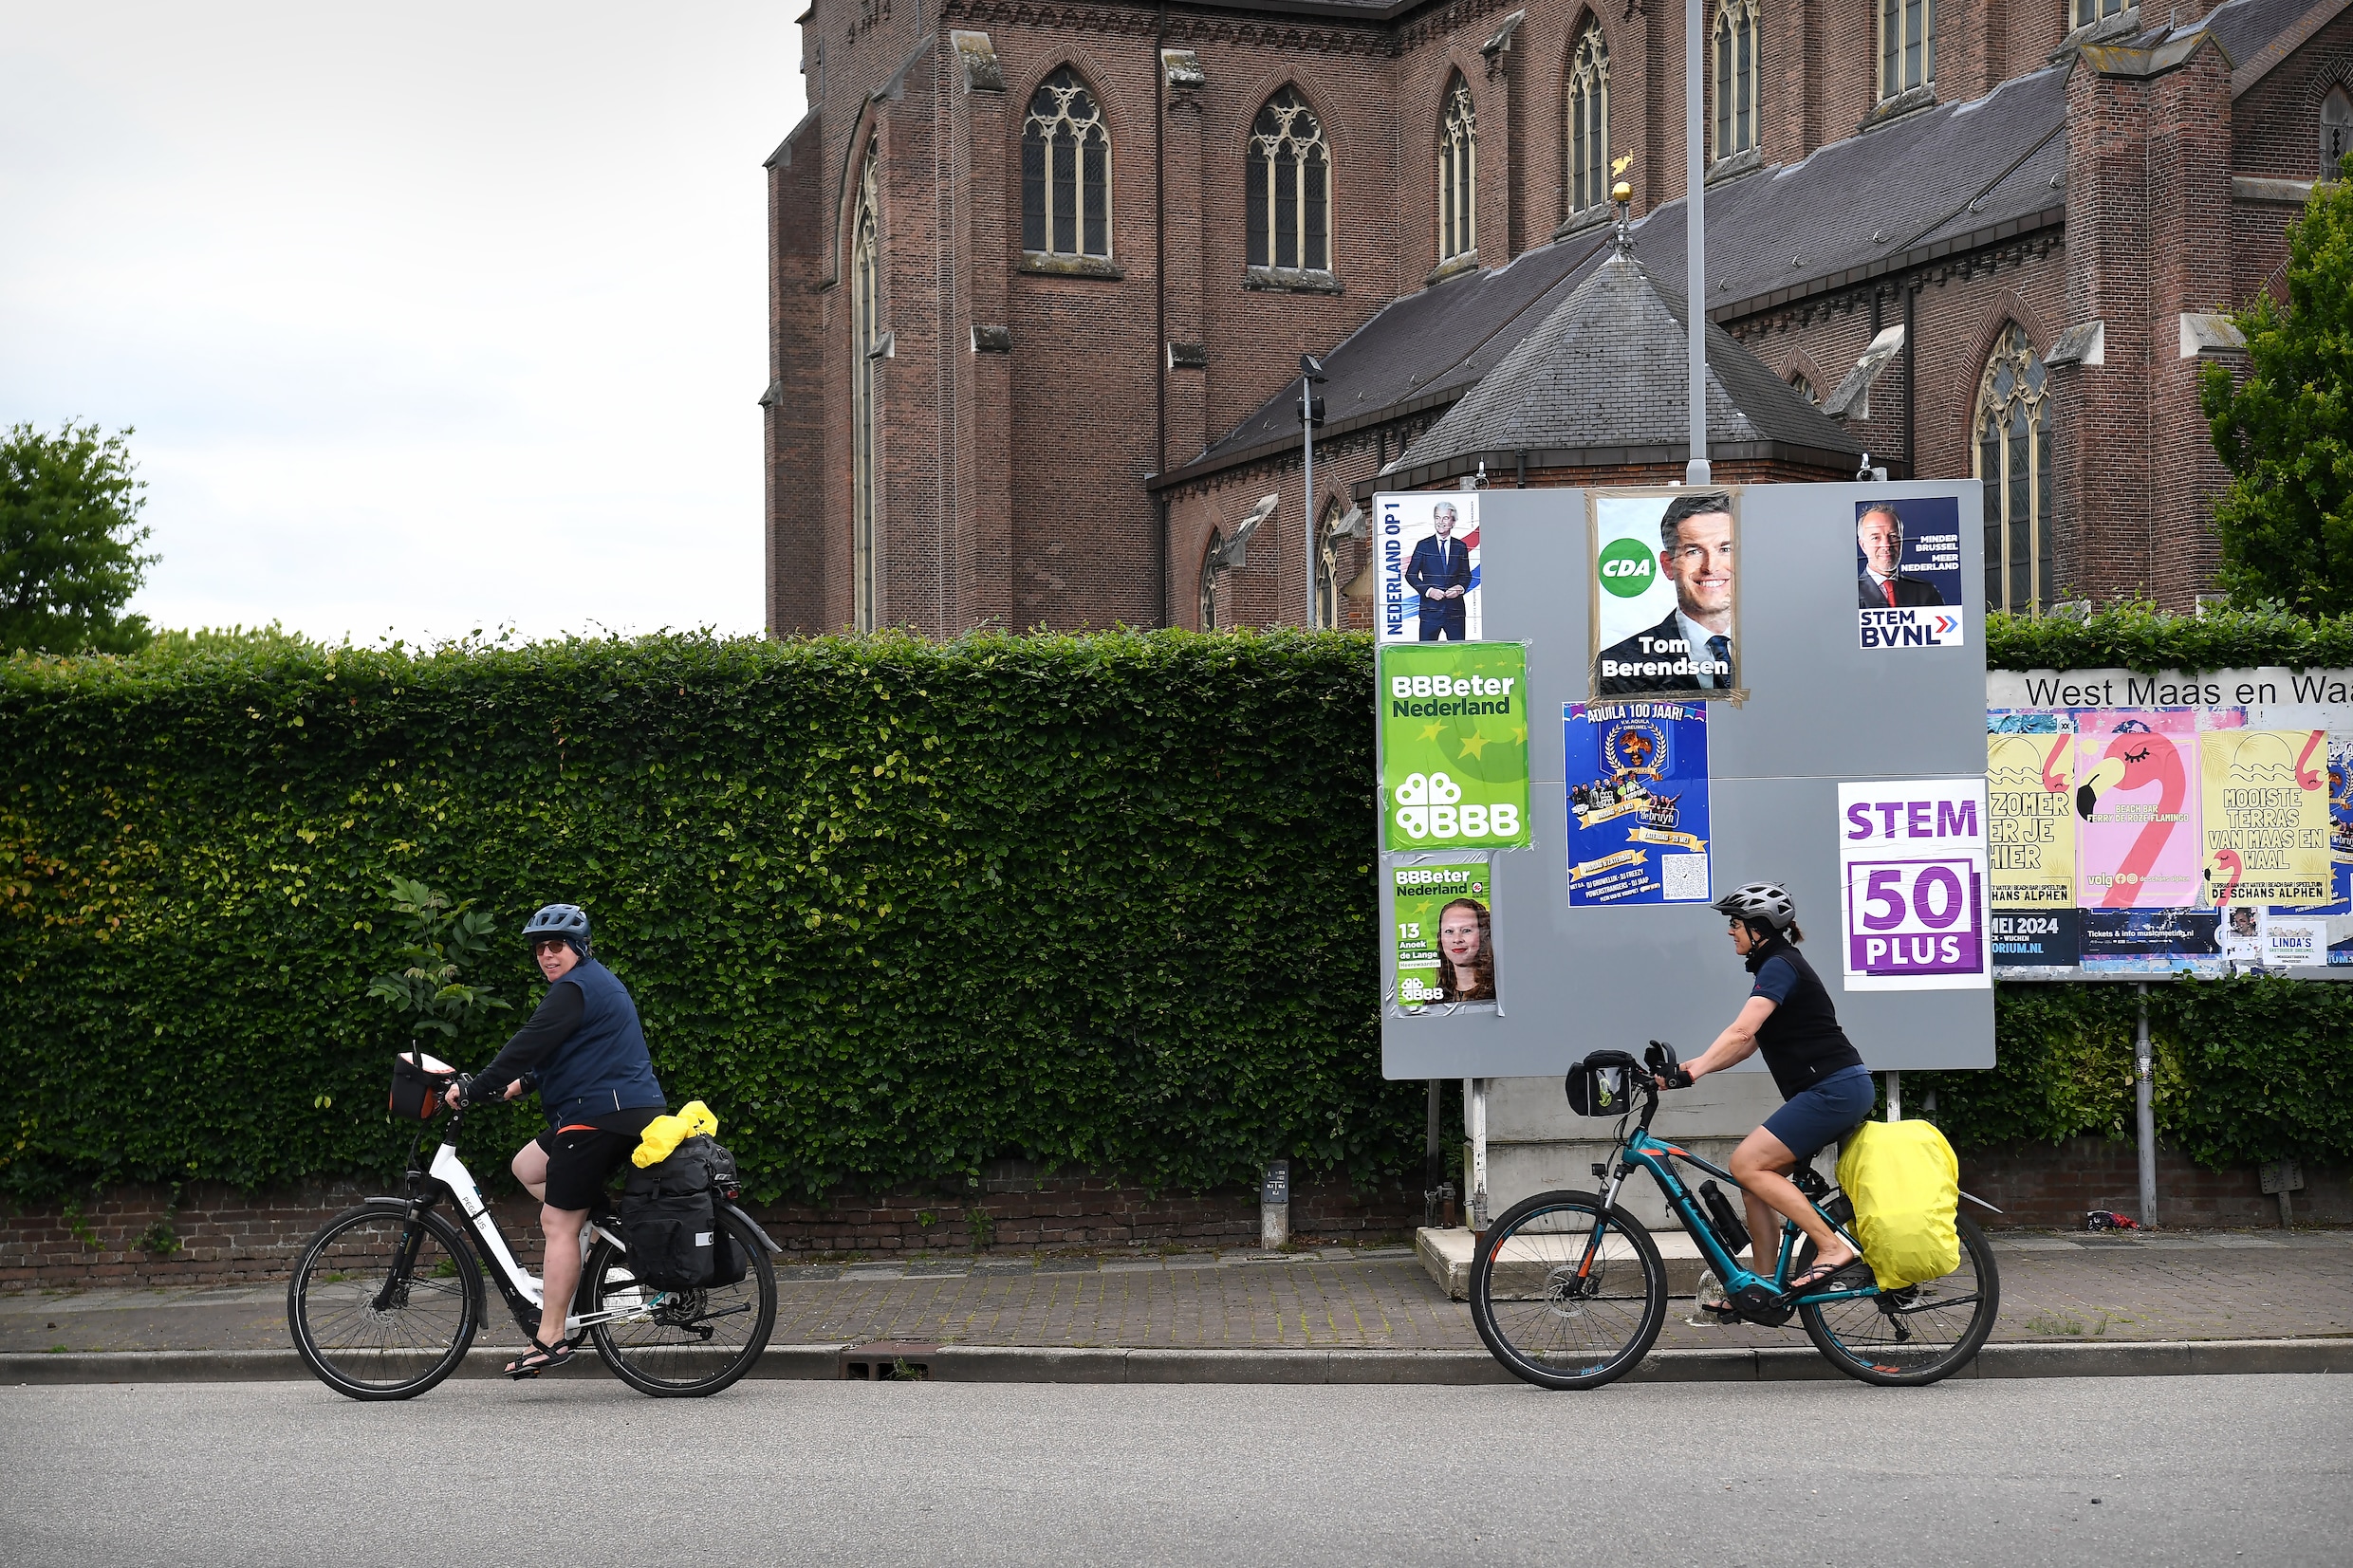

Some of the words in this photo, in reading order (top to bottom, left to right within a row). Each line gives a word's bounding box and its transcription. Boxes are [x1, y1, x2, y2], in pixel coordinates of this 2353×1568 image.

[1385, 513, 1400, 535] OP
[1916, 543, 1958, 552] BRUSSEL
[1920, 534, 1958, 544] MINDER
[1602, 559, 1650, 577] CDA
[1901, 563, 1959, 572] NEDERLAND
[1932, 554, 1958, 563] MEER
[1386, 540, 1402, 636] NEDERLAND
[1861, 610, 1916, 625] STEM
[1639, 636, 1691, 655] Tom
[1861, 625, 1941, 648] BVNL
[1602, 657, 1729, 677] Berendsen
[1392, 674, 1515, 698] BBBeter
[2026, 678, 2113, 706] West
[2128, 678, 2221, 705] Maas
[2235, 683, 2276, 704] en
[1393, 697, 1510, 717] Nederland
[1587, 705, 1626, 724] AQUILA
[1629, 704, 1650, 718] 100
[1652, 704, 1684, 721] JAAR!
[1991, 791, 2069, 817] ZOMER
[2223, 788, 2302, 808] MOOISTE
[1596, 808, 1615, 821] VRIJDAG
[1618, 805, 1625, 814] 24
[1624, 802, 1634, 813] MEI
[1649, 810, 1675, 824] bruyn
[2086, 814, 2114, 822] FERRY
[2115, 814, 2125, 822] DE
[2127, 814, 2149, 822] ROZE
[2150, 814, 2189, 822] FLAMINGO
[2115, 804, 2140, 813] BEACH
[2142, 804, 2158, 813] BAR
[1429, 803, 1520, 839] BBB
[1847, 800, 1978, 839] STEM
[2226, 809, 2300, 828] TERRAS
[1644, 832, 1669, 841] ZATERDAG
[2023, 819, 2054, 842] JE
[2208, 830, 2243, 849] VAN
[2248, 829, 2295, 849] MAAS
[2299, 829, 2324, 848] EN
[1584, 862, 1603, 873] VRIJDAG
[1607, 854, 1632, 865] ZATERDAG
[1990, 844, 2041, 869] HIER
[2244, 850, 2289, 870] WAAL
[1396, 870, 1470, 885] BBBeter
[1626, 868, 1643, 879] FREEZY
[2087, 873, 2114, 888] volg
[1397, 883, 1468, 896] Nederland
[1862, 865, 1963, 931] 50
[1992, 891, 2020, 901] HANS
[2024, 891, 2067, 901] ALPHEN
[2213, 889, 2226, 898] DE
[2231, 889, 2274, 898] SCHANS
[2279, 888, 2323, 897] ALPHEN
[1399, 923, 1420, 939] 13
[2017, 917, 2059, 934] 2024
[1866, 935, 1961, 966] PLUS
[2272, 937, 2311, 947] LINDA'S
[1412, 950, 1438, 959] Lange
[1413, 987, 1443, 1000] BBB
